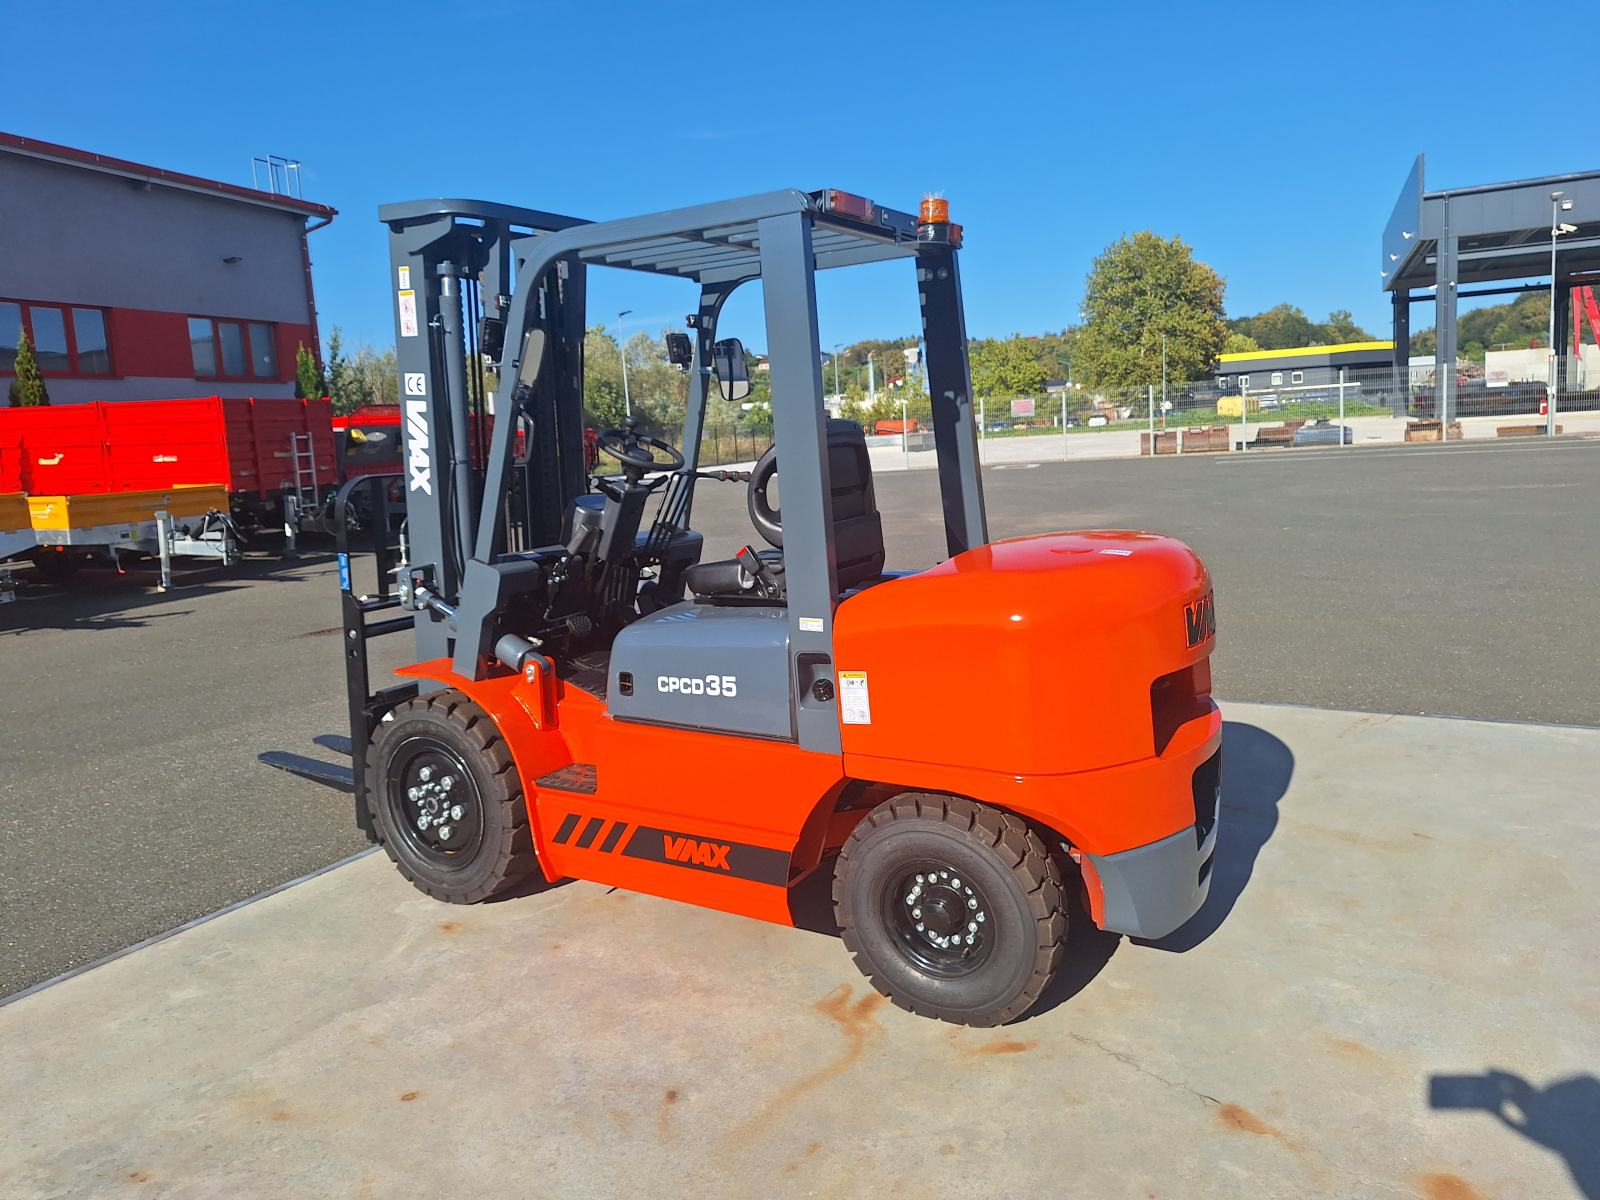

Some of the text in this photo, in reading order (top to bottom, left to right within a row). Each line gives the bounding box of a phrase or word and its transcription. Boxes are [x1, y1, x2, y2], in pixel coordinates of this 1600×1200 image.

[406, 375, 423, 393] CE
[406, 400, 432, 496] VMX
[1184, 591, 1217, 648] VM
[663, 834, 732, 871] VMX
